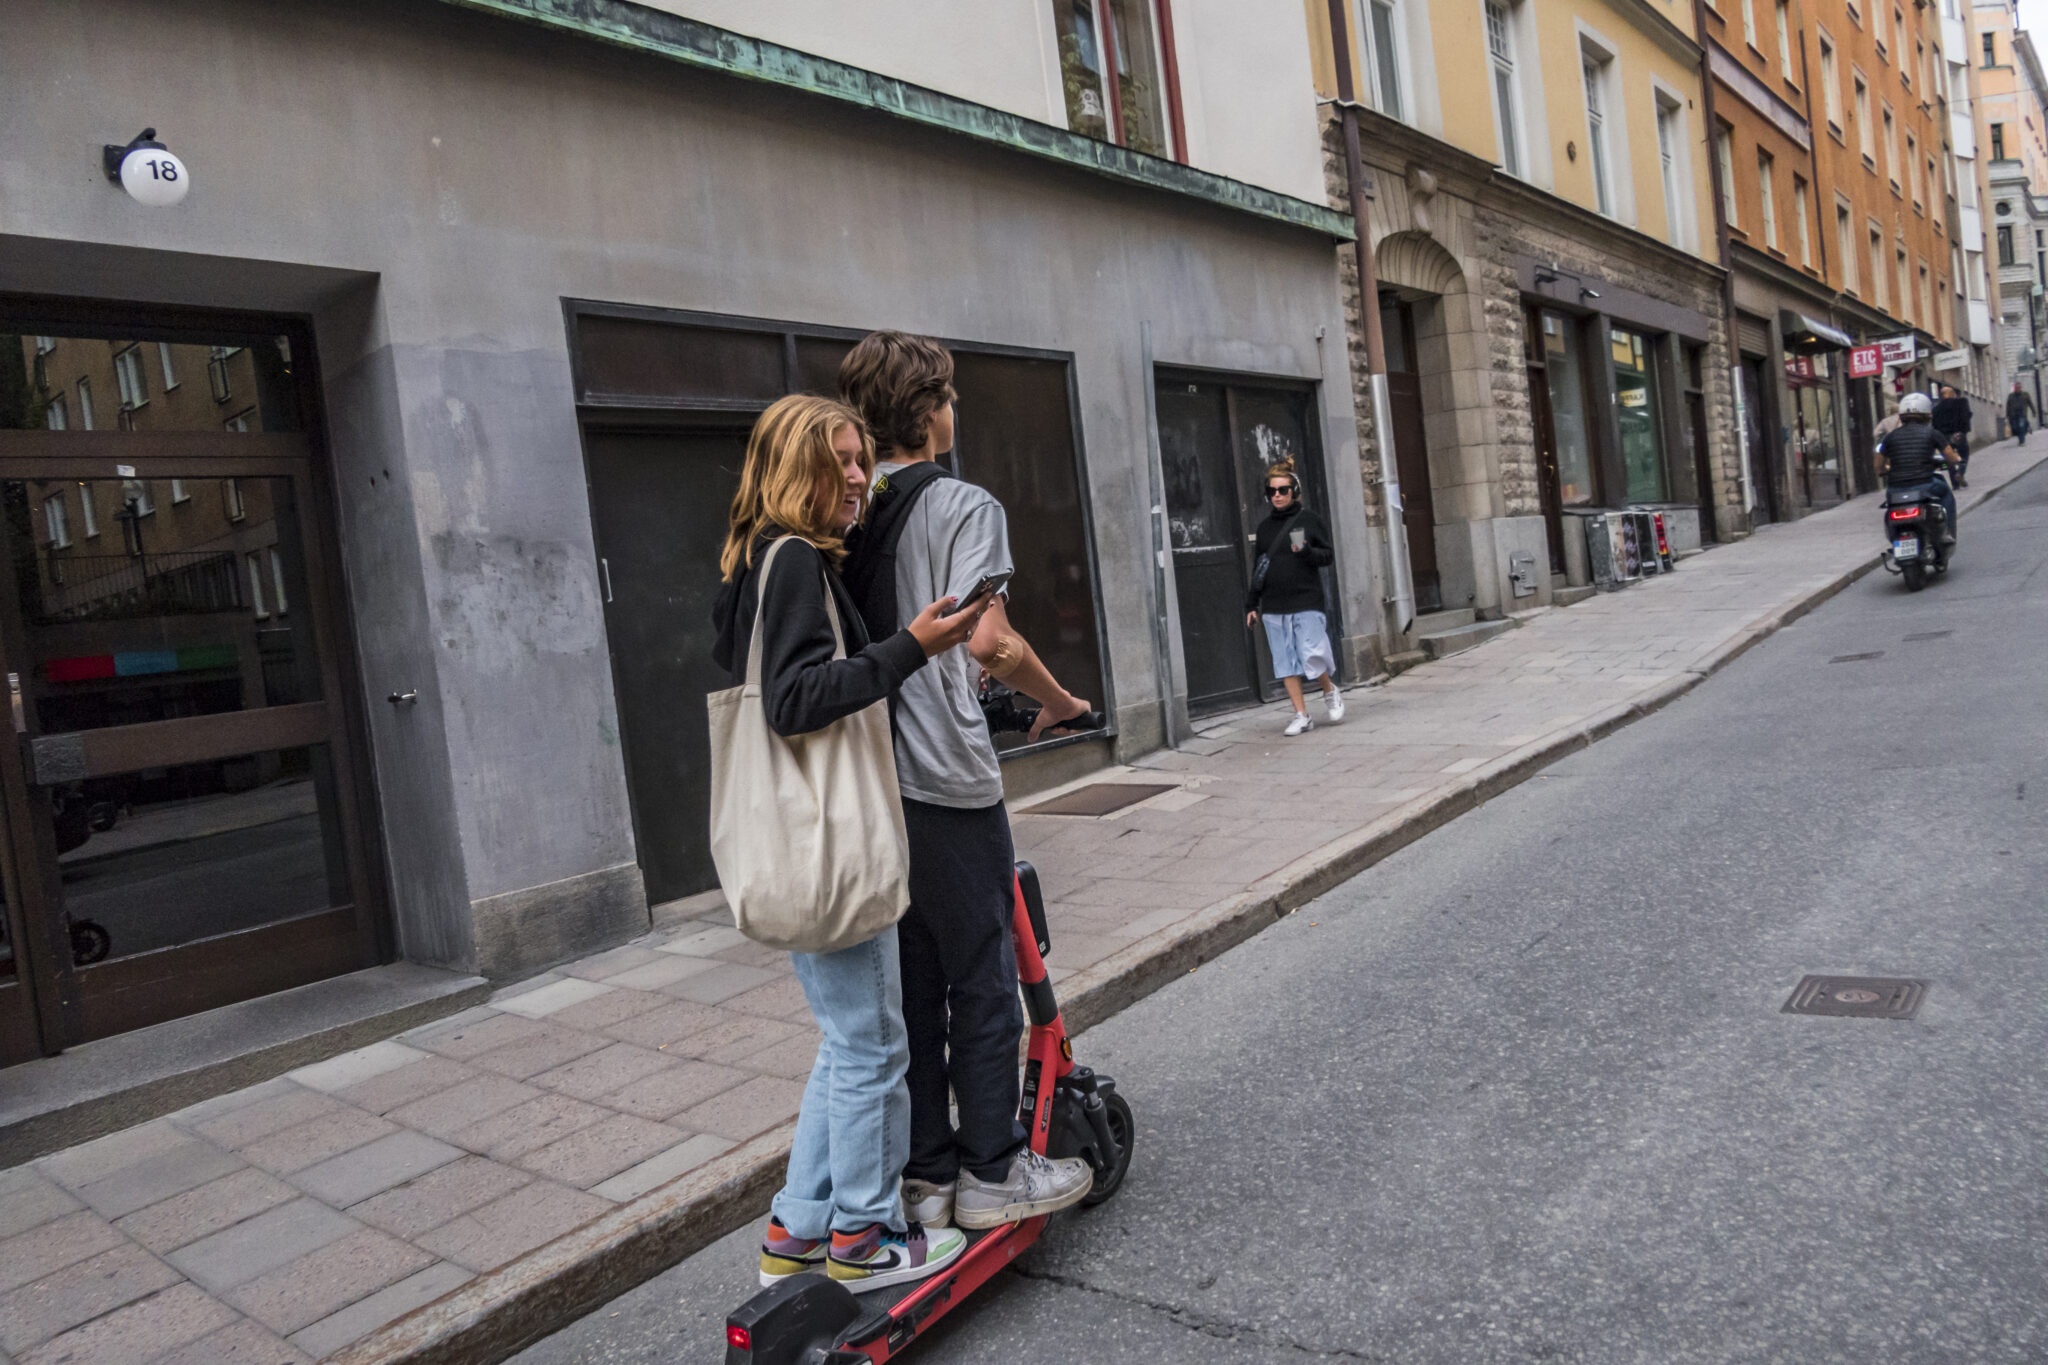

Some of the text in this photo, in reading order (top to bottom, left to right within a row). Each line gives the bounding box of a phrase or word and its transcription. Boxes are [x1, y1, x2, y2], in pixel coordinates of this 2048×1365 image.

[146, 159, 178, 182] 18
[1853, 349, 1876, 365] ETC
[1854, 363, 1877, 373] STUDIO
